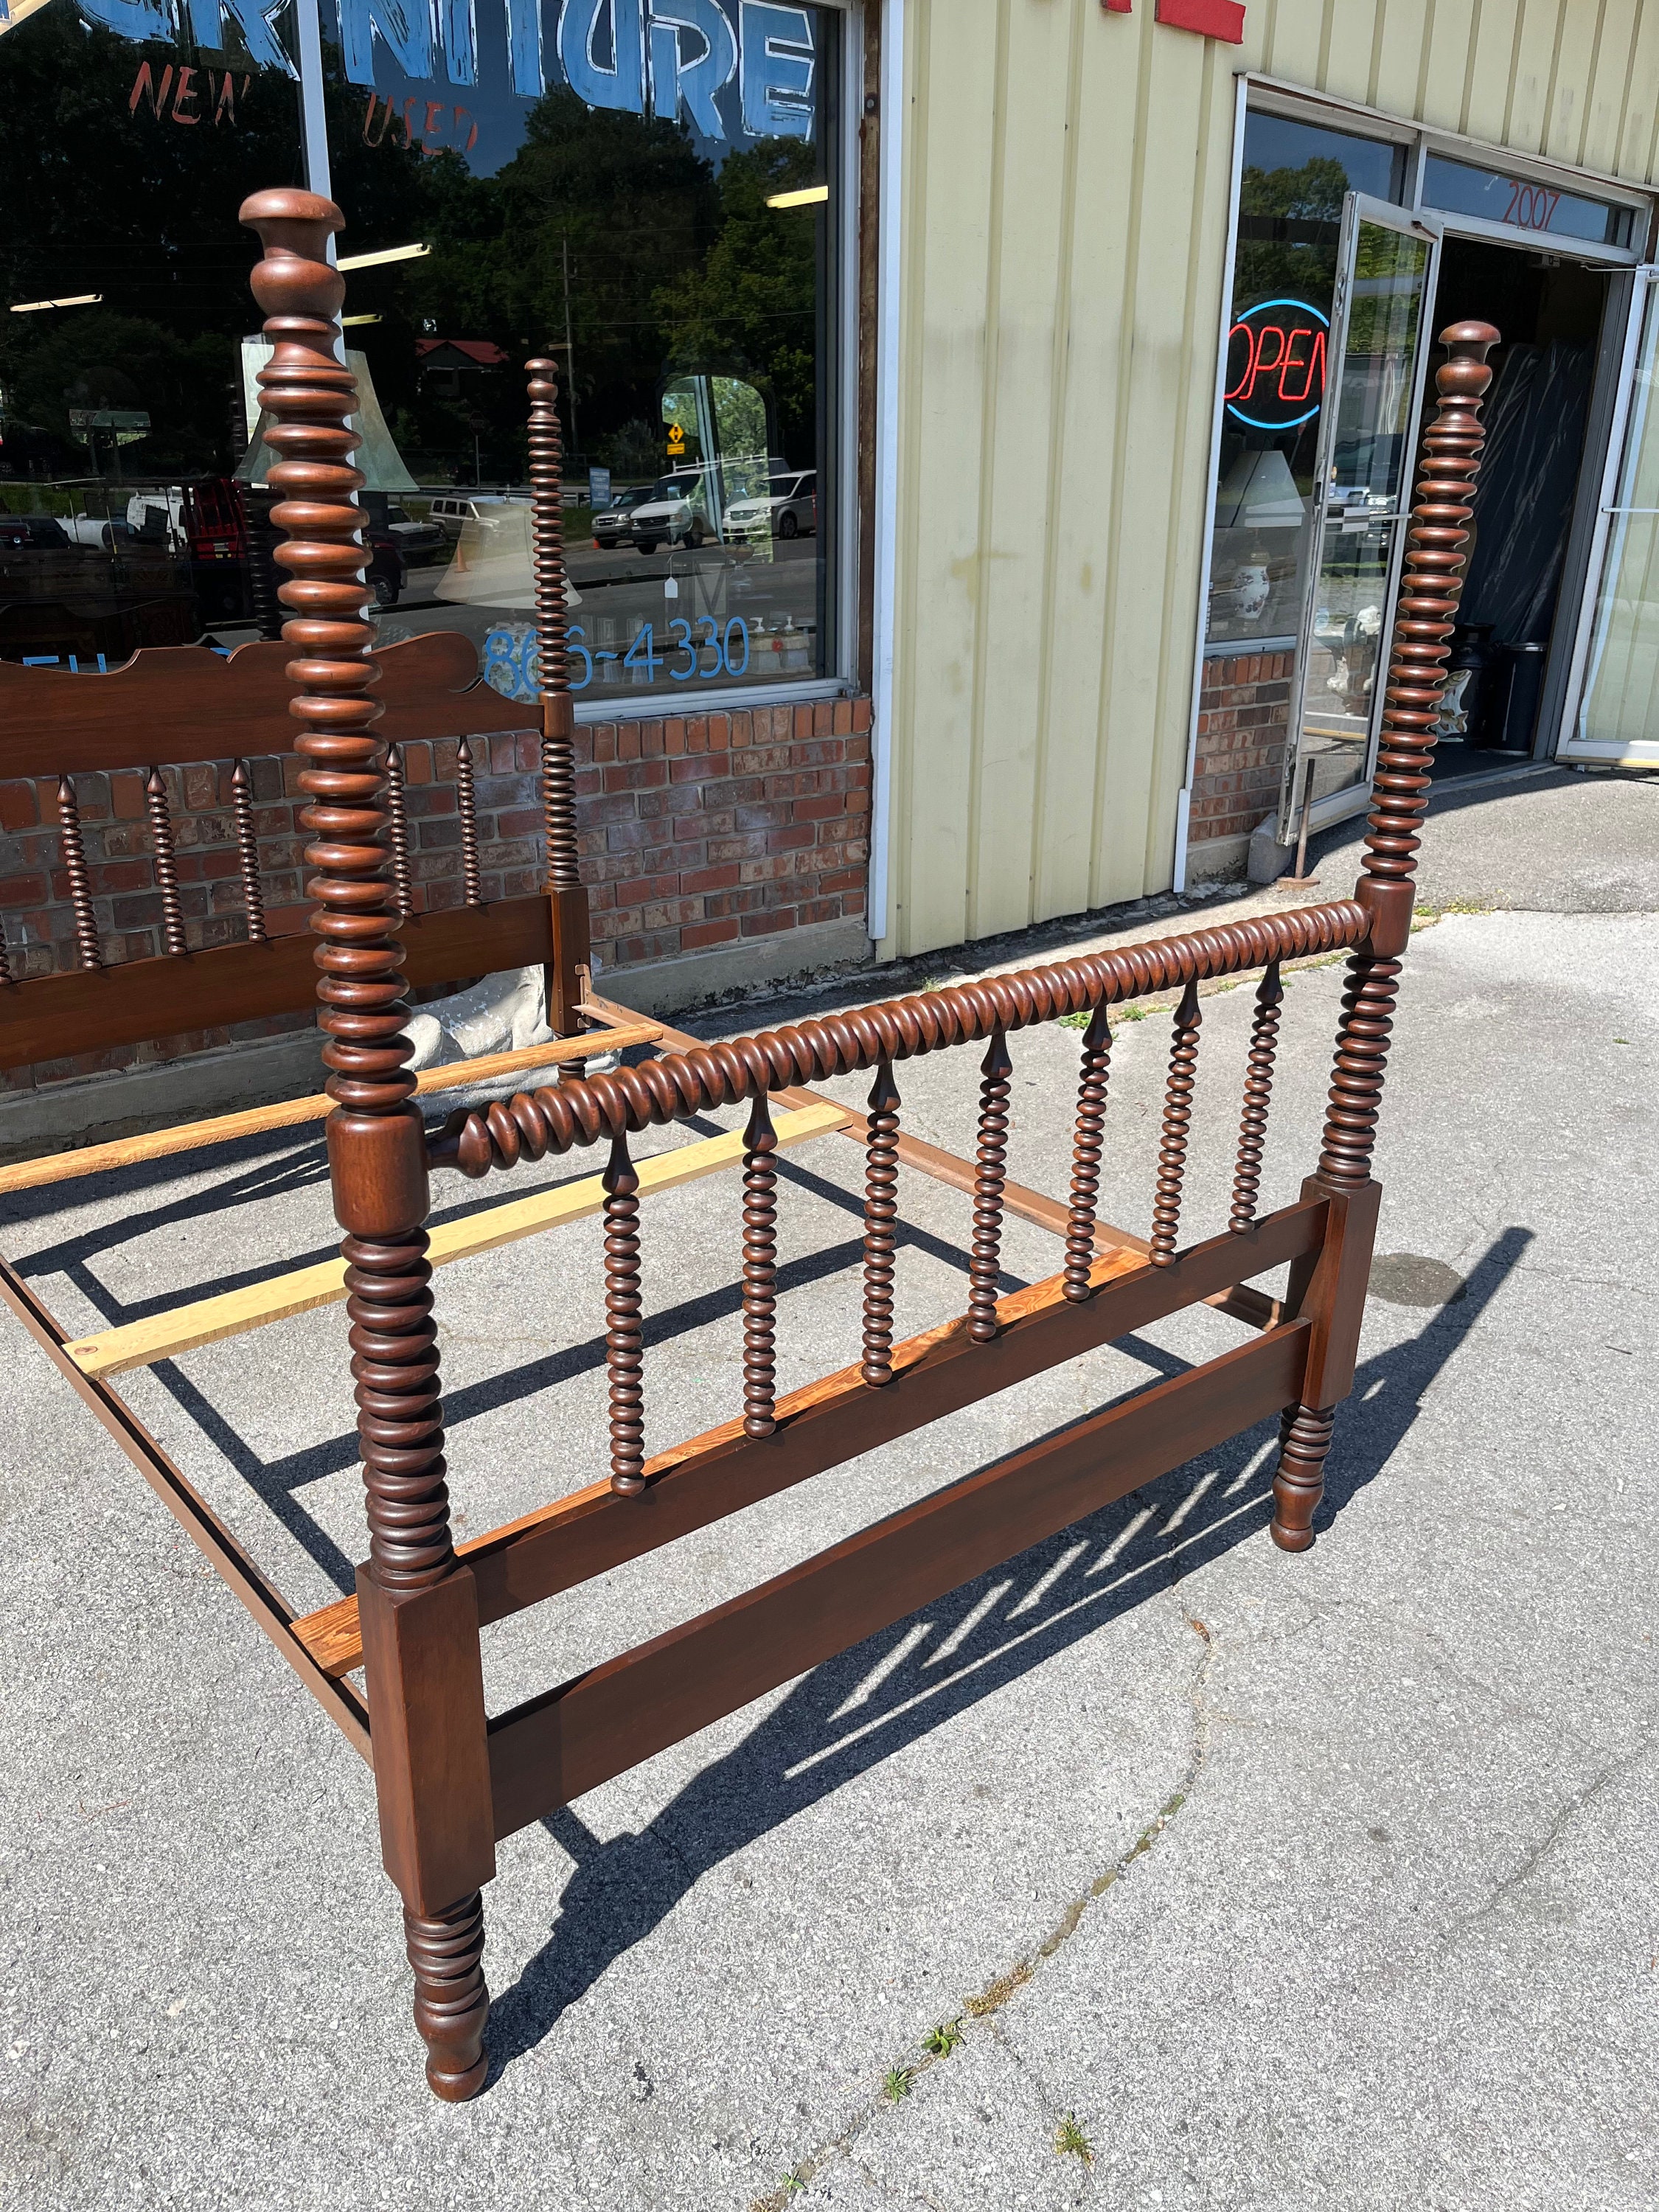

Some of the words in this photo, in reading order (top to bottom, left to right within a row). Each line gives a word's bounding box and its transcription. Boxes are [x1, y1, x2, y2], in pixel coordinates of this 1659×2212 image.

[129, 61, 251, 127] NEW
[363, 92, 478, 156] USED
[1501, 181, 1561, 231] 2007
[1223, 323, 1326, 401] OPEN
